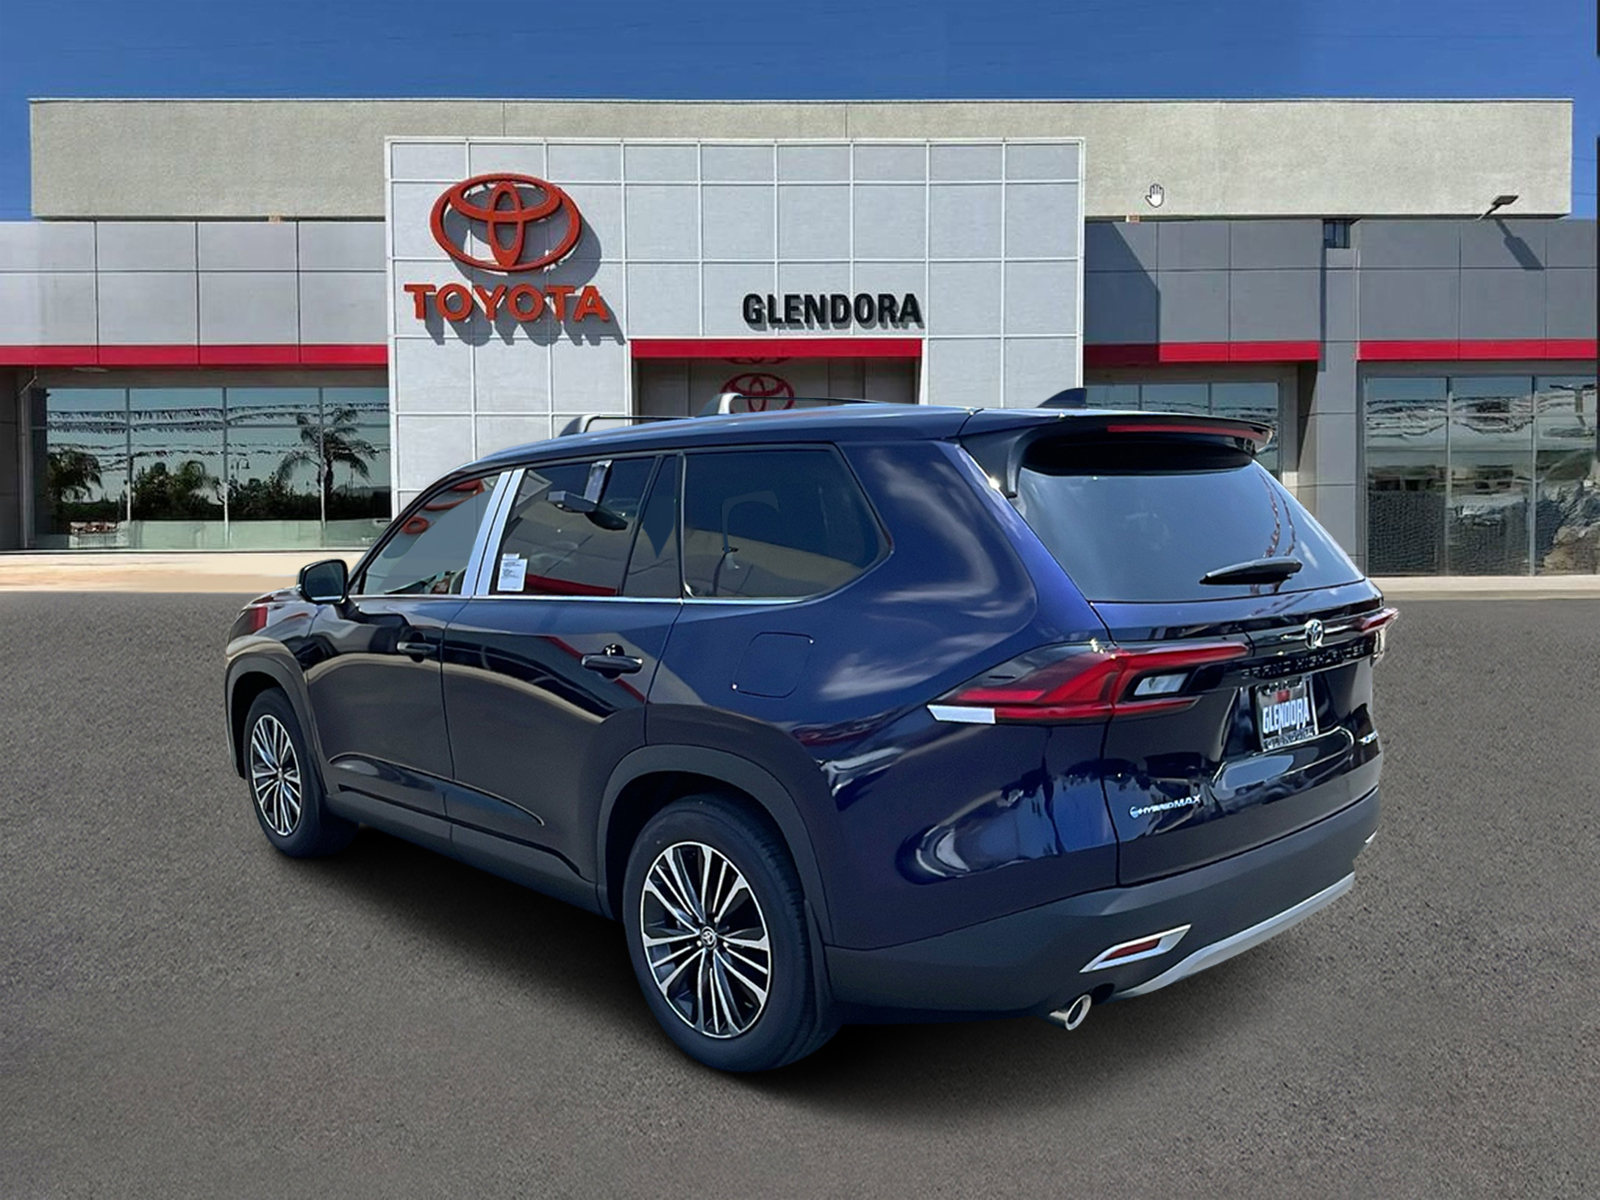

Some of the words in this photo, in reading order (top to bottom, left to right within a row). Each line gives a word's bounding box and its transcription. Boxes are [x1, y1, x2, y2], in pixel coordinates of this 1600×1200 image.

[404, 284, 610, 323] TOYOTA
[742, 293, 923, 326] GLENDORA
[1263, 696, 1310, 734] GLENDORA
